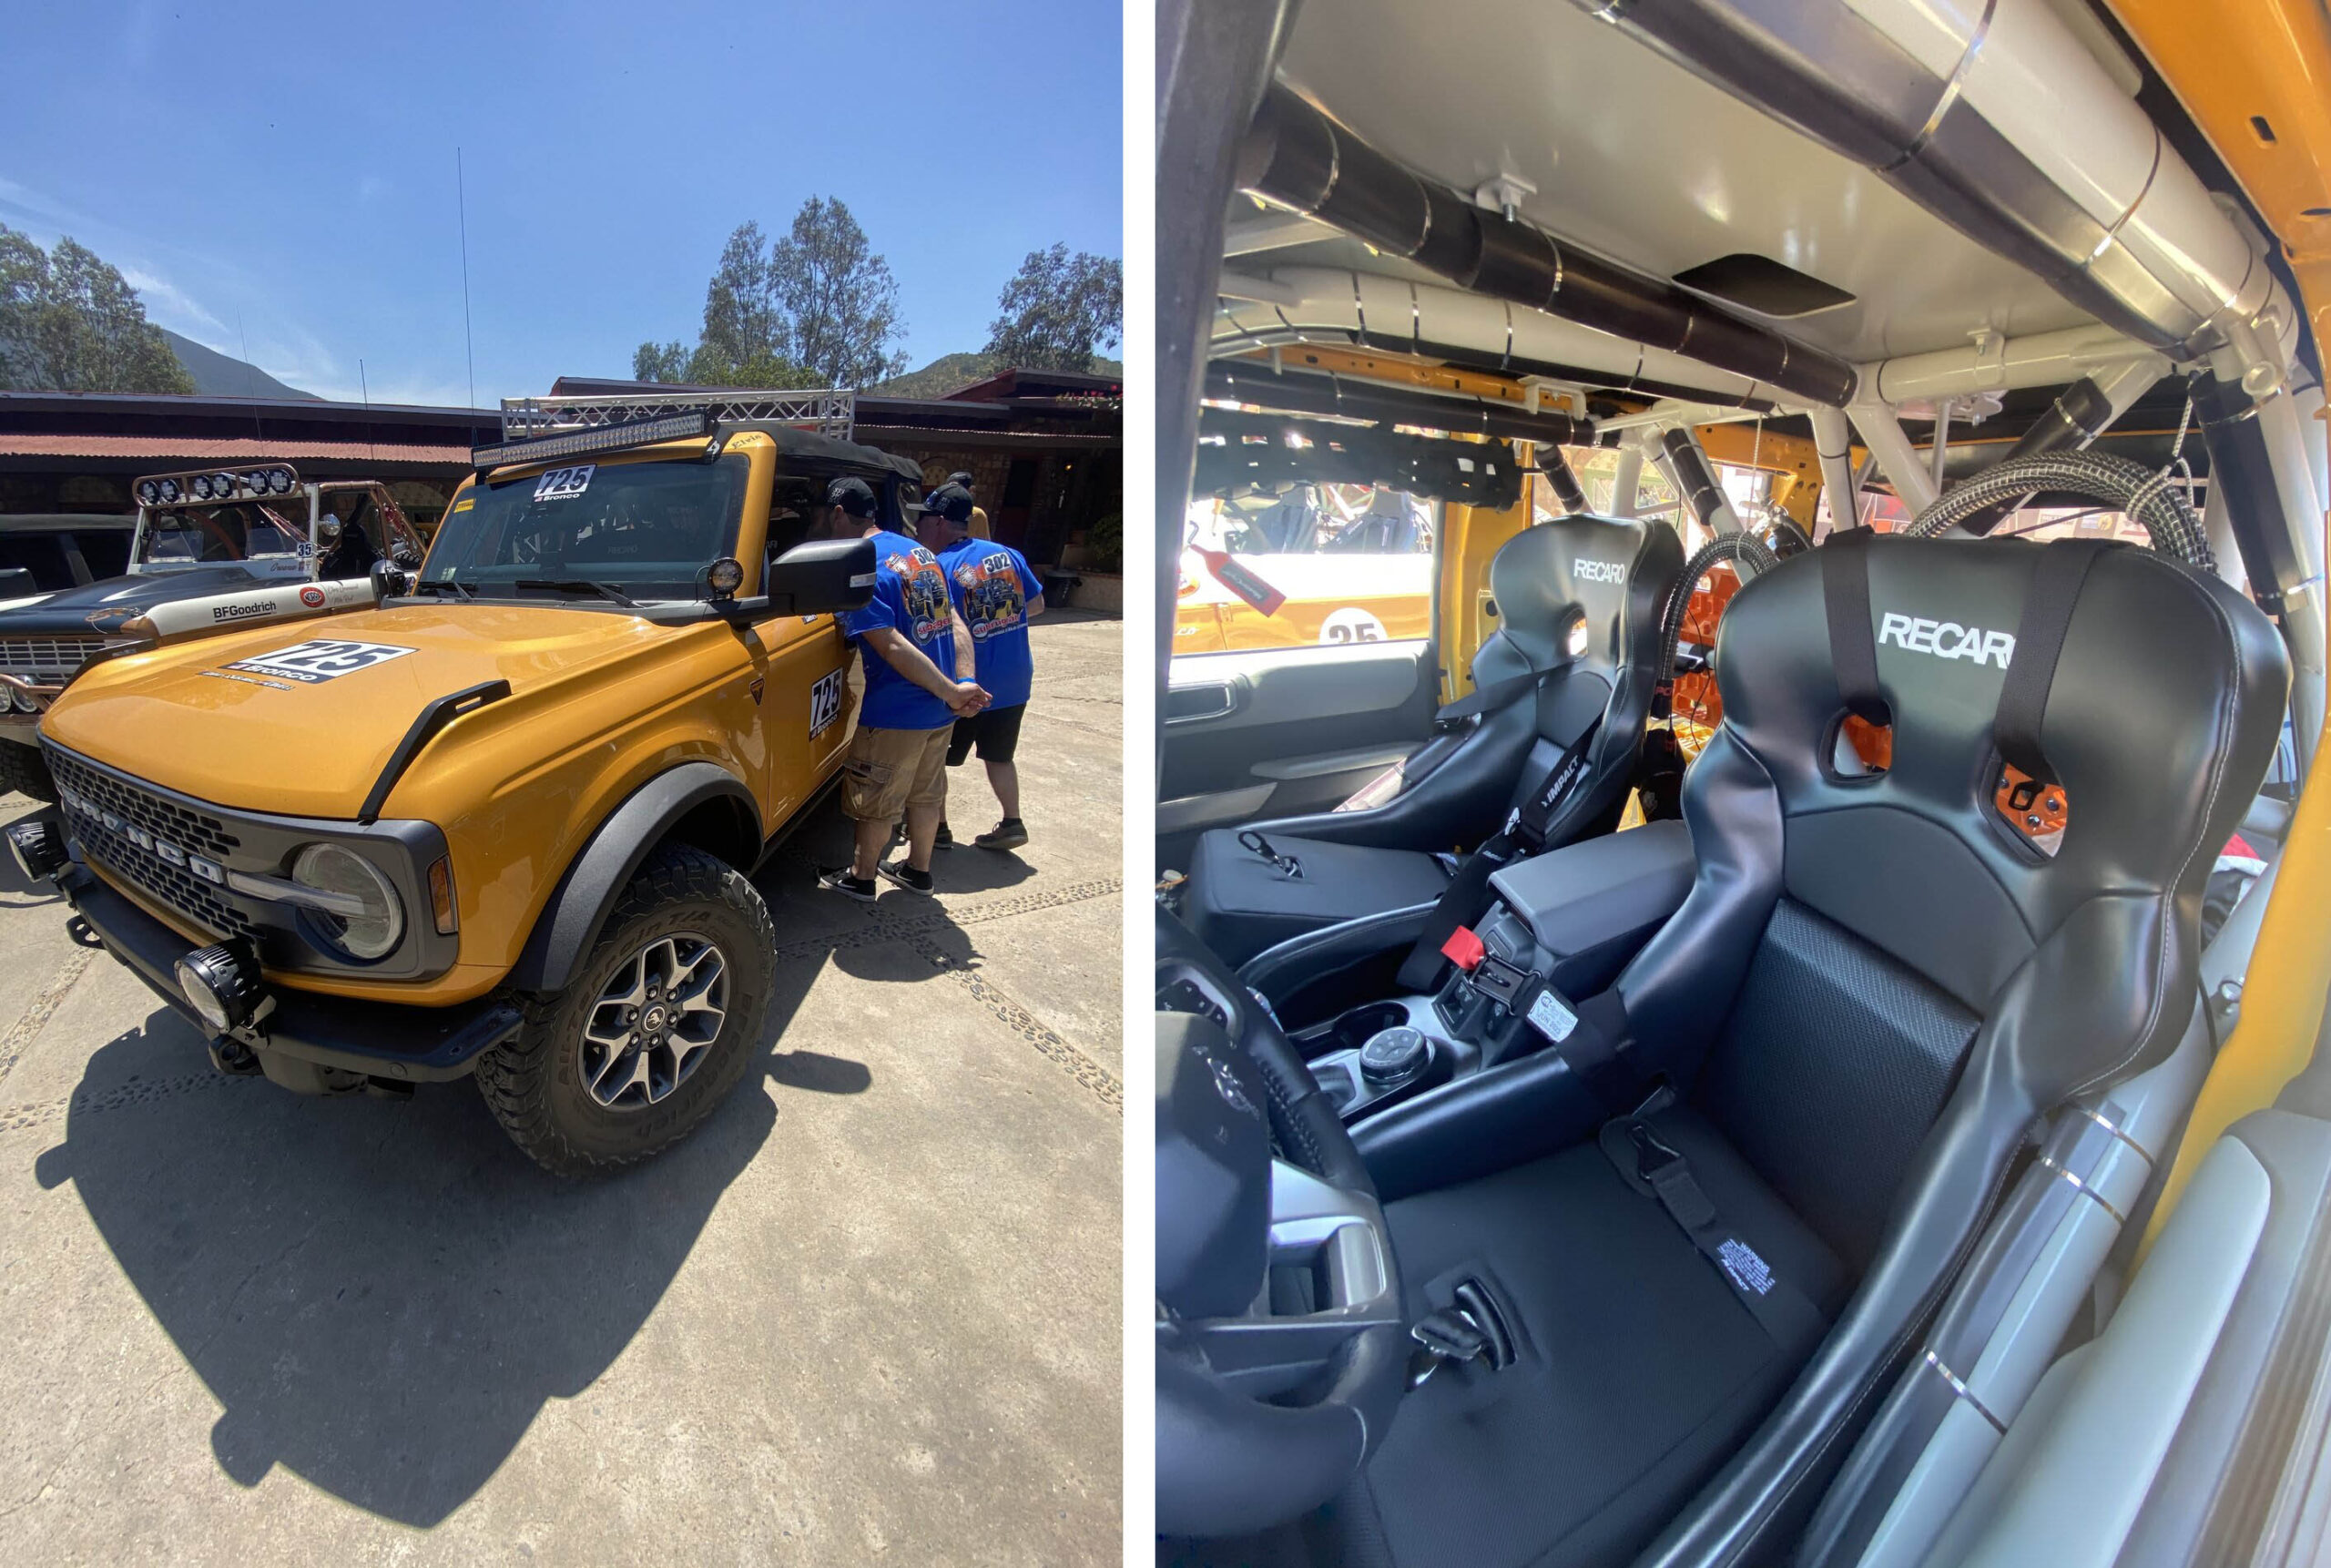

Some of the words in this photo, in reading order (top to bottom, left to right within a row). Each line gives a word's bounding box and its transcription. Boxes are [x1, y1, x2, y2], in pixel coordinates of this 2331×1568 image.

[541, 467, 591, 494] 725
[544, 493, 580, 501] Bronco
[299, 544, 311, 556] 35
[913, 548, 936, 565] 302
[984, 554, 1011, 573] 302
[1573, 558, 1625, 585] RECARO
[213, 601, 277, 618] BFGoodrich
[1878, 612, 2017, 670] RECAR
[253, 641, 402, 671] 725
[244, 665, 318, 681] Bronco
[812, 671, 842, 728] 725
[1546, 754, 1579, 803] IMPACT
[61, 785, 224, 884] BRONCO
